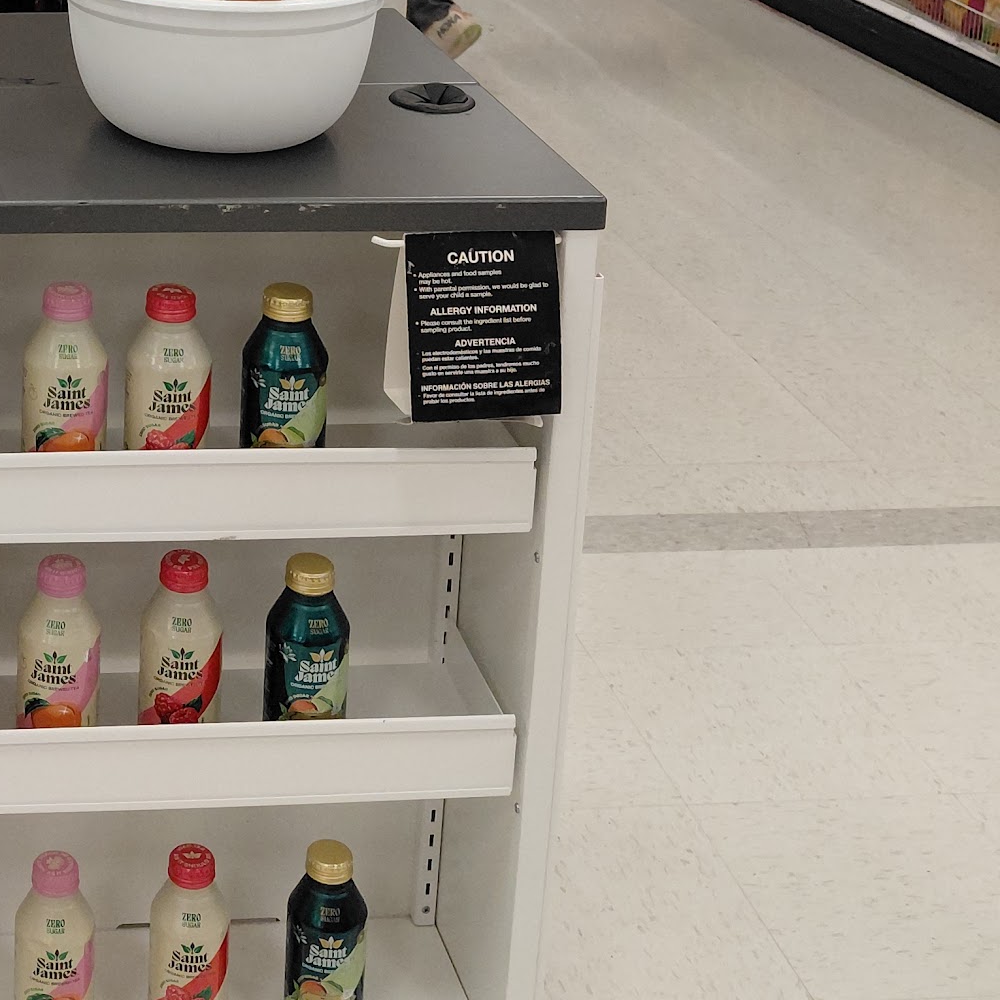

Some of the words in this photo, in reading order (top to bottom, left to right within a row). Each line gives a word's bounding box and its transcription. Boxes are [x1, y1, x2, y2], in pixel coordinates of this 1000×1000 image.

[447, 250, 515, 264] CAUTION
[478, 269, 502, 277] samples
[430, 306, 472, 316] ALLERGY
[474, 304, 537, 314] INFORMATION
[455, 337, 516, 347] ADVERTENCIA
[163, 348, 184, 357] ZERO
[421, 383, 471, 391] INFORMACIÓN
[473, 382, 497, 390] SOBRE
[499, 381, 513, 389] LAS
[515, 379, 550, 387] ALERGIAS
[48, 386, 86, 400] Saint
[153, 389, 192, 403] Saint
[269, 387, 309, 401] Saint
[44, 399, 90, 411] James
[149, 401, 196, 414] James
[172, 617, 192, 627] ZERO
[35, 659, 72, 675] Saint
[161, 657, 199, 671] Saint
[300, 659, 338, 673] Saint
[31, 670, 77, 685] James
[157, 668, 203, 680] James
[182, 913, 201, 922] ZERO
[172, 951, 208, 964] Saint
[309, 944, 348, 958] Saint
[36, 958, 73, 970] Saint
[168, 960, 212, 973] James
[306, 955, 347, 968] Jame
[33, 966, 77, 980] James
